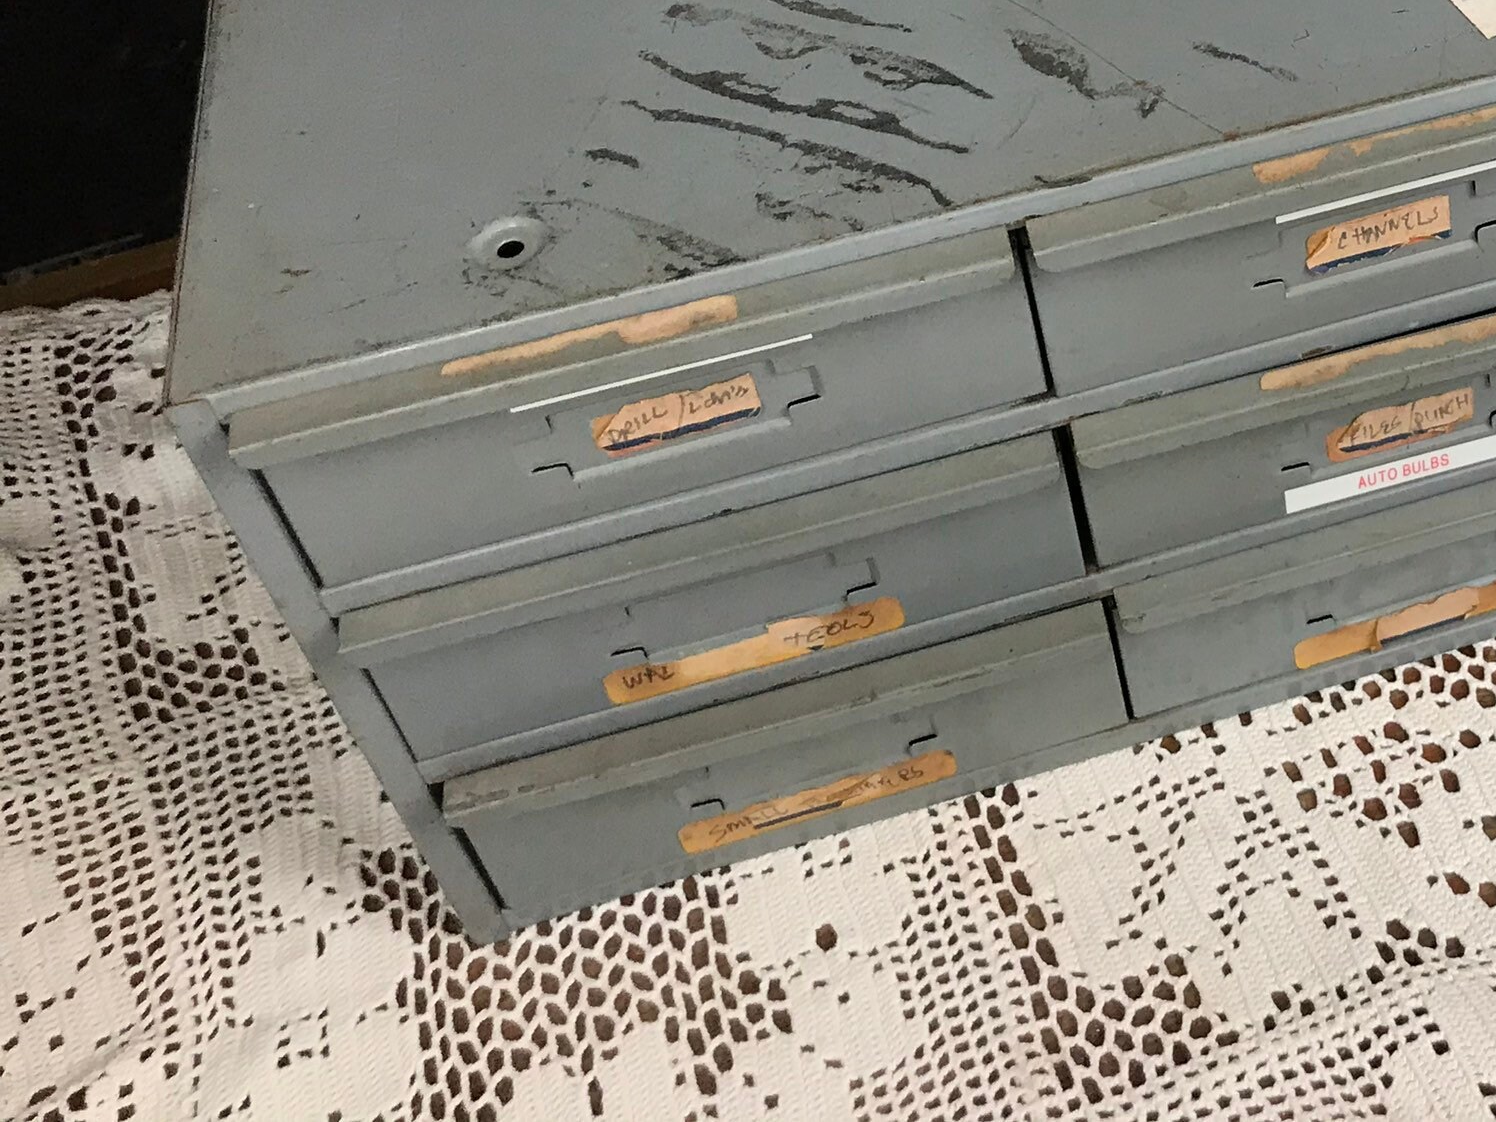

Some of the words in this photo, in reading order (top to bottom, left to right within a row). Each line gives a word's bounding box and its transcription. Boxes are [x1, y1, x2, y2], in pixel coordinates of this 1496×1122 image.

[1336, 205, 1440, 250] CHANNELS
[1357, 466, 1398, 490] AUTO
[1401, 453, 1451, 477] BULBS
